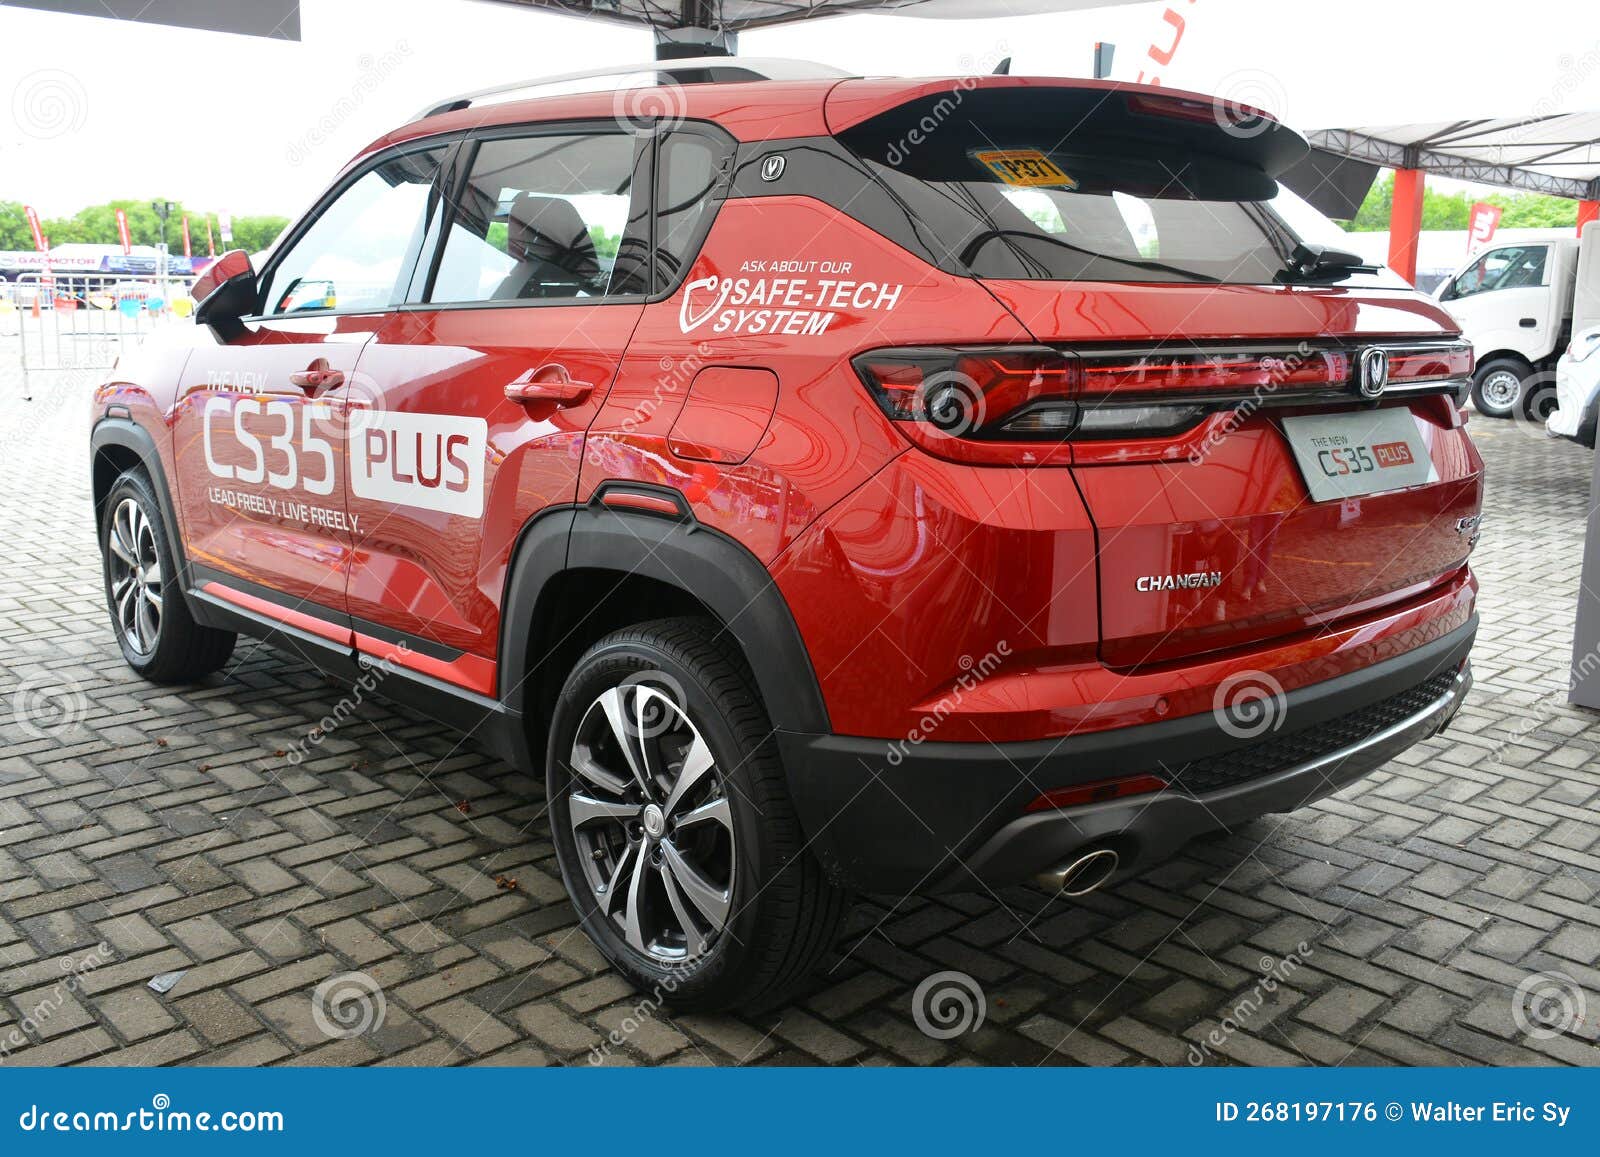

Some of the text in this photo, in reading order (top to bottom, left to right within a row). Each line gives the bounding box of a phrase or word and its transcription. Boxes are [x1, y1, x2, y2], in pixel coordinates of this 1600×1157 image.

[740, 260, 852, 274] ASK ABOUT OUR
[730, 278, 903, 311] SAFE-TECH
[713, 309, 835, 336] SYSTEM
[207, 370, 268, 395] THE NEW
[203, 396, 470, 496] CS35 PLUS
[1311, 435, 1349, 448] THE NEW
[1317, 445, 1411, 477] CS35 PLUS
[208, 486, 364, 534] LEAD FREELY. LIVE FREELY.
[1136, 571, 1222, 592] CHANGAN
